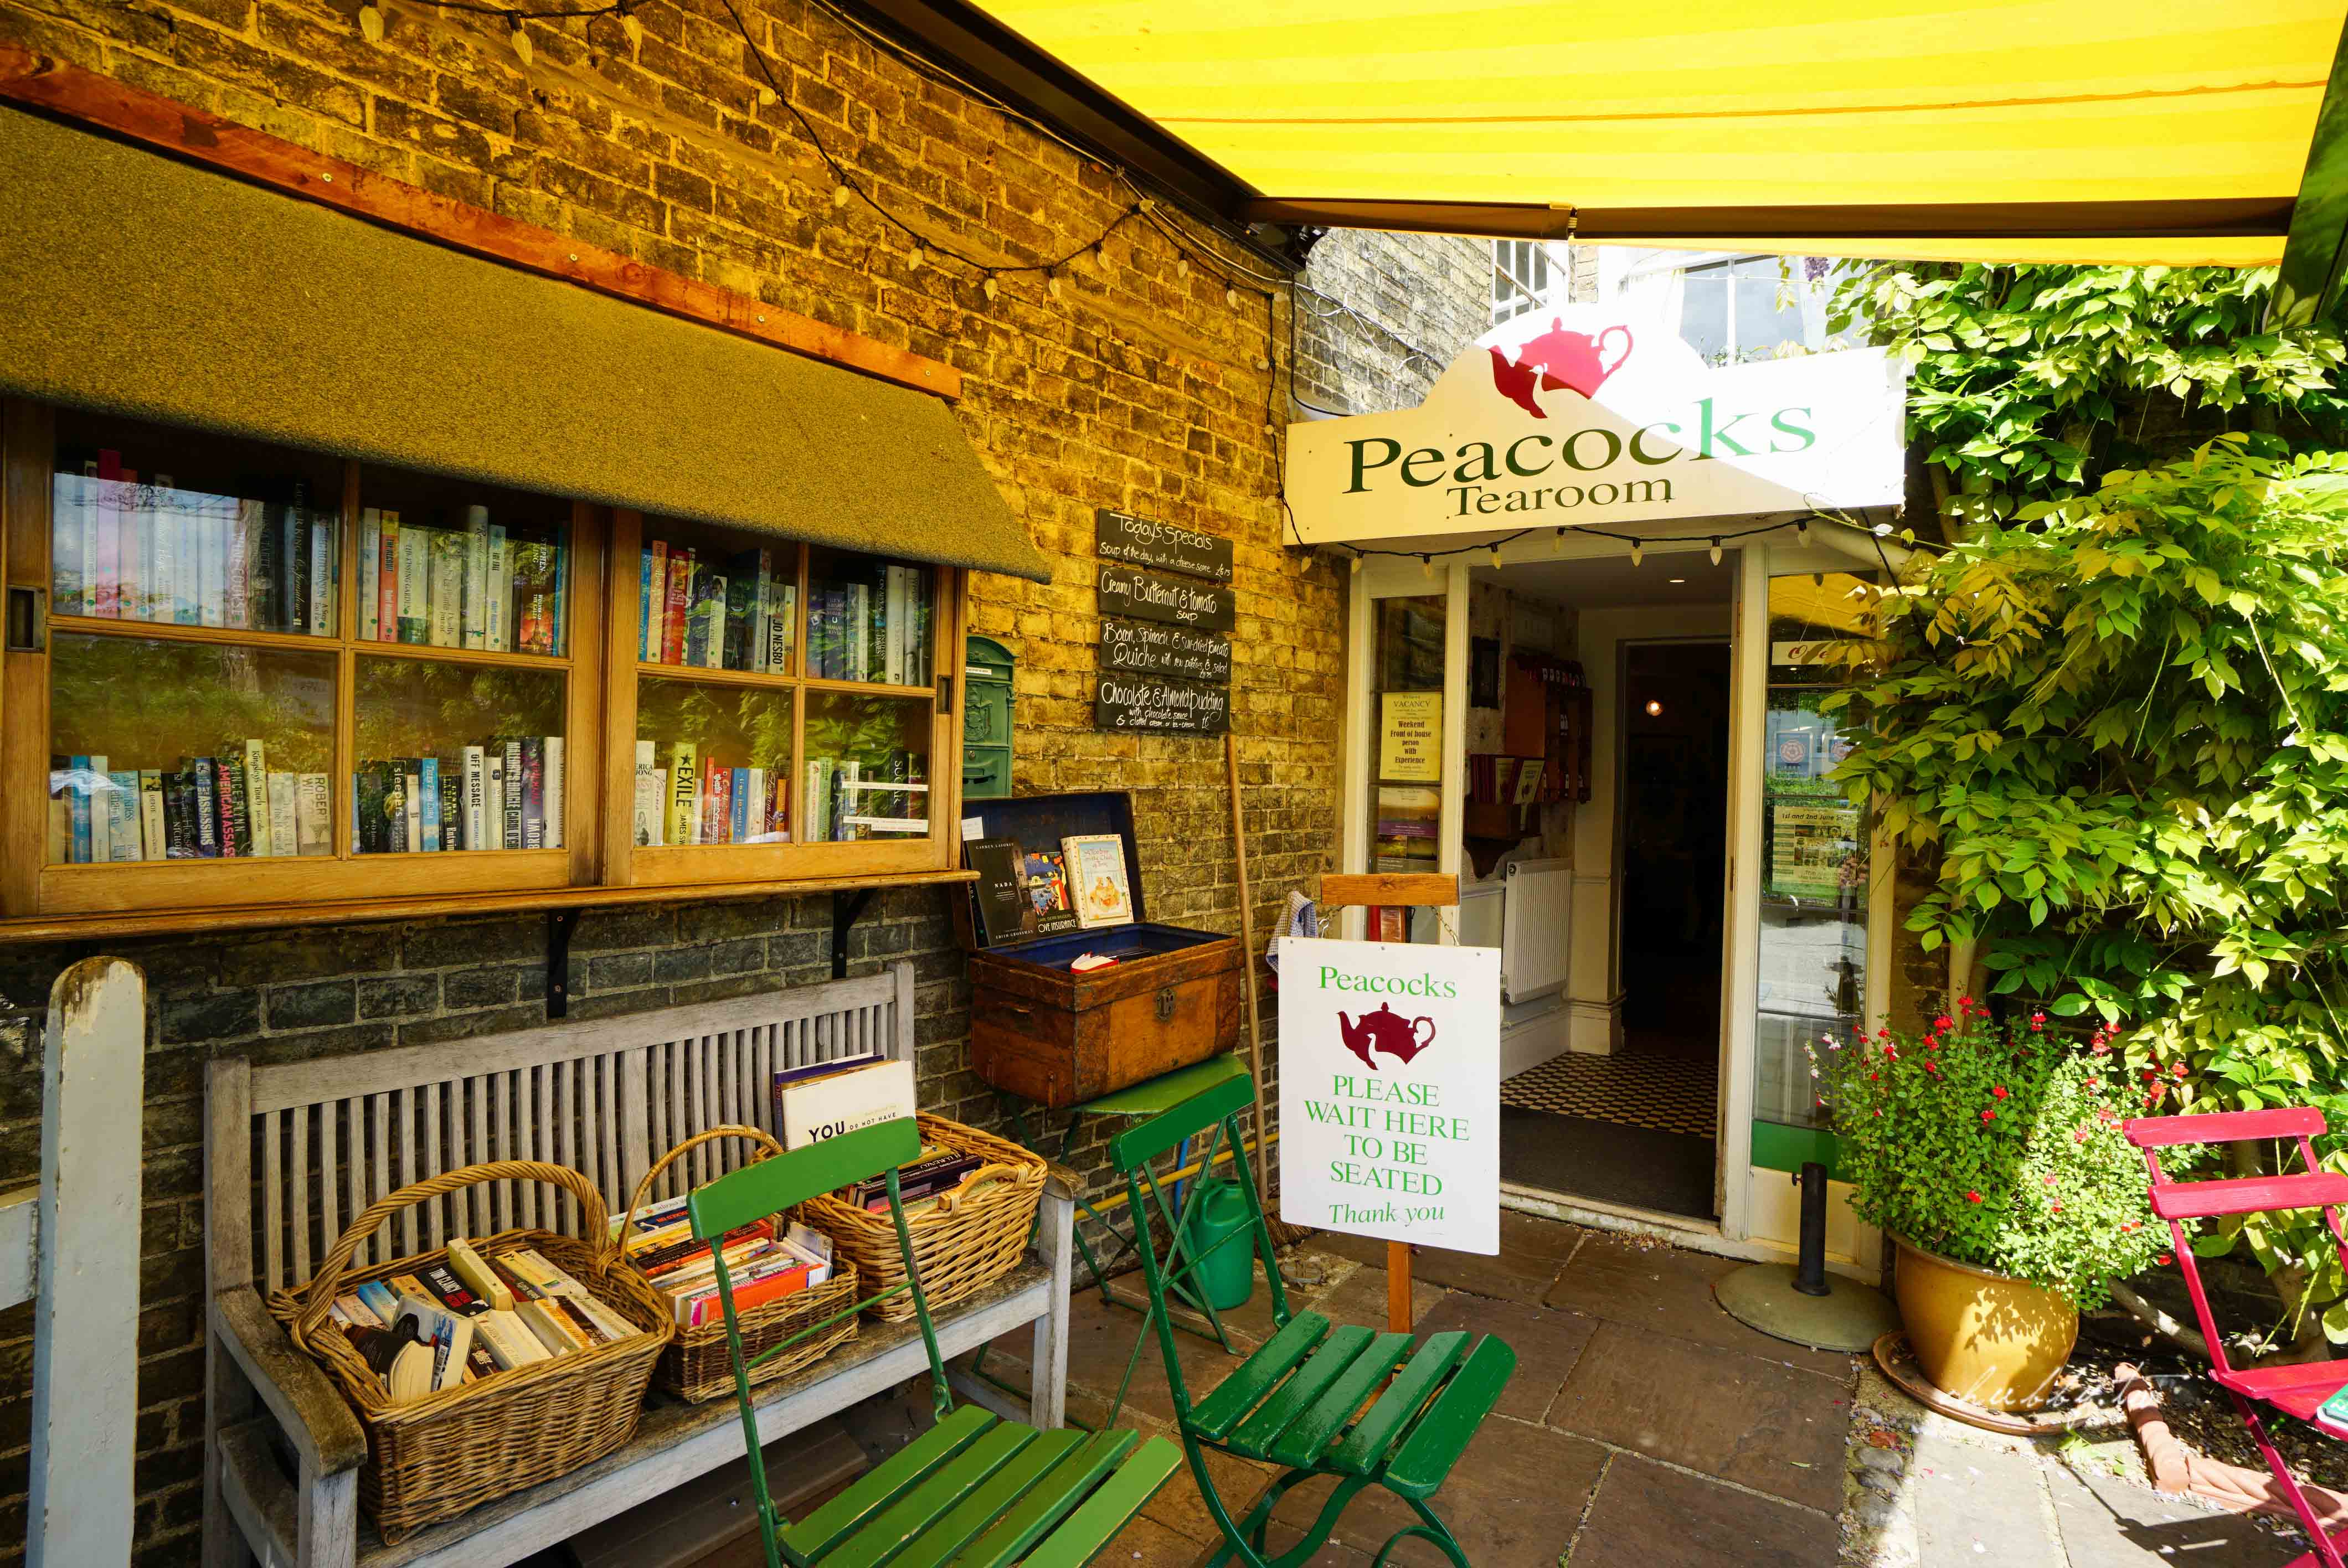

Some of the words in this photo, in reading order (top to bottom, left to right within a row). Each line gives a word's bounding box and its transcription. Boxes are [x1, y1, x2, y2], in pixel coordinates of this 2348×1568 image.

[1342, 397, 1816, 494] Peacocks
[1446, 478, 1674, 517] Tearoom
[1110, 513, 1162, 545] Today's
[1162, 526, 1213, 554] Specials
[533, 543, 541, 563] KING
[539, 535, 548, 572] STEPHEN
[1099, 541, 1121, 558] Soup
[1130, 545, 1140, 559] the
[1156, 553, 1168, 566] with
[1176, 555, 1196, 569] cheese
[1101, 571, 1131, 607] Creamy
[1133, 576, 1180, 608] Butternut
[1179, 590, 1188, 609] &
[773, 618, 784, 632] JO
[1176, 610, 1198, 625] soup
[773, 633, 783, 664] NESBO
[1113, 642, 1160, 669] Quiche
[1161, 652, 1172, 666] with
[1174, 657, 1184, 668] new
[1136, 627, 1170, 653] Spinach
[1101, 682, 1152, 708] Chocolate
[1152, 687, 1162, 708] &
[1161, 685, 1191, 711] Almond
[1129, 706, 1143, 719] with
[1144, 706, 1172, 721] chocolate
[1172, 711, 1190, 721] sauce
[1129, 716, 1148, 727] clotted
[471, 754, 480, 769] OFF
[218, 764, 233, 818] AMERICAN
[230, 765, 244, 796] VINCE
[393, 767, 405, 817] sleepers
[470, 771, 481, 808] MESSAGE
[676, 767, 693, 808] EXILE
[314, 777, 328, 822] ROBERT
[197, 796, 214, 846] ASSASSINS
[231, 801, 246, 832] FLYNN
[506, 811, 519, 831] CAROL
[679, 814, 687, 834] JAMES
[1051, 919, 1077, 931] INSURANCE
[1318, 965, 1457, 998] Peacocks
[1332, 1075, 1440, 1107] PLEASE
[809, 1121, 846, 1142] YOU
[862, 1118, 875, 1127] NOT
[878, 1112, 897, 1121] HAVE
[1304, 1100, 1376, 1129] WAIT
[1384, 1110, 1470, 1141] HERE
[1344, 1134, 1383, 1159] TO
[1393, 1141, 1428, 1165] BE
[1330, 1160, 1443, 1196] SEATED
[1329, 1202, 1399, 1224] Thank
[1404, 1206, 1445, 1227] you
[428, 1267, 448, 1281] TOM
[436, 1275, 462, 1294] CLANCY
